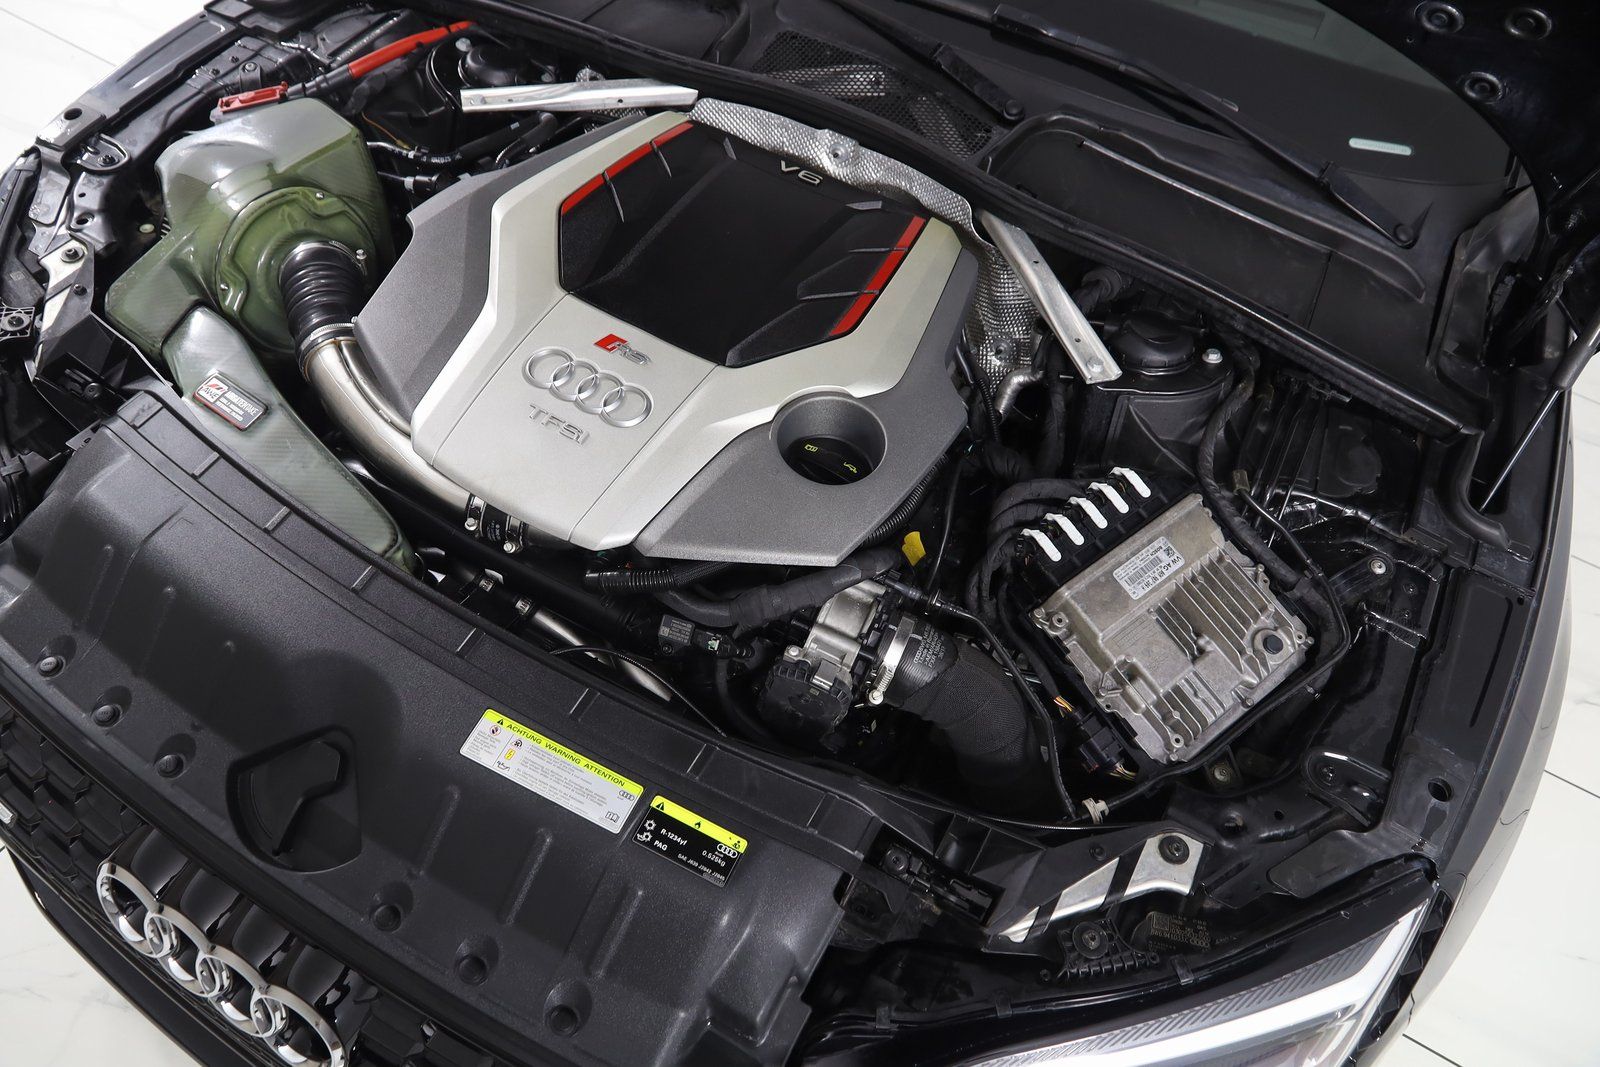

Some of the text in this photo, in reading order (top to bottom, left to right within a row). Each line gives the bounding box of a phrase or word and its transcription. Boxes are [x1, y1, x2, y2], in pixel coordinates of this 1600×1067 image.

[781, 160, 824, 185] V6
[525, 404, 590, 445] TFSI
[1162, 555, 1181, 571] VW AG
[506, 723, 542, 745] ACHTUNG
[545, 741, 581, 764] WARNING
[583, 763, 625, 787] ATTENTION
[653, 839, 668, 851] PAG
[660, 828, 688, 846] R-1234yf
